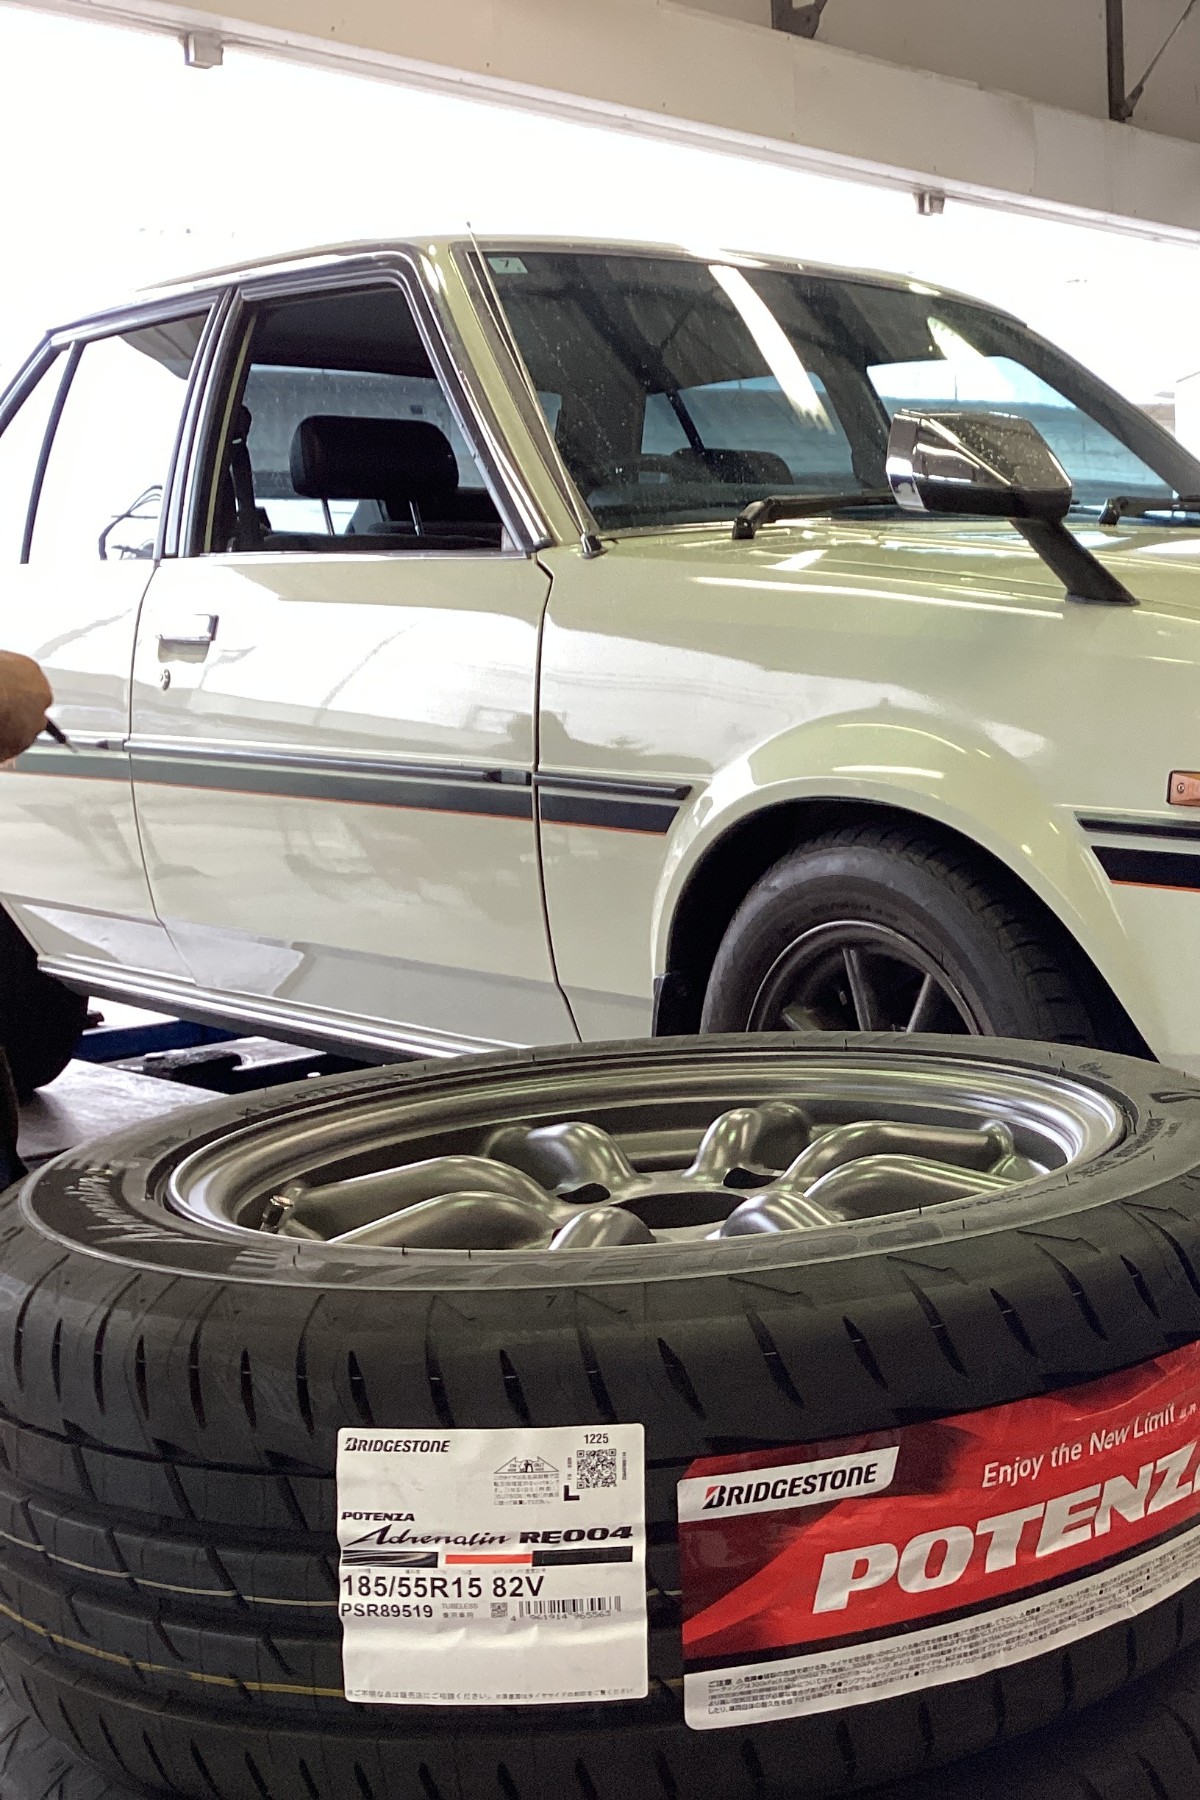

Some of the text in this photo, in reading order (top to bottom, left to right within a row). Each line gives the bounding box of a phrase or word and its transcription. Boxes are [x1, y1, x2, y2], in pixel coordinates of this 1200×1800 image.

[344, 1437, 450, 1453] BRIDGESTONE
[584, 1433, 609, 1444] 1225
[981, 1402, 1175, 1488] Enjoy the New Limit
[564, 1485, 580, 1501] L
[702, 1462, 878, 1510] BRIDGESTONE
[341, 1512, 415, 1522] POTENZA
[344, 1524, 633, 1547] Adrenalin RE004
[343, 1575, 544, 1598] 185/55R15 82V
[341, 1603, 433, 1618] PSR89519
